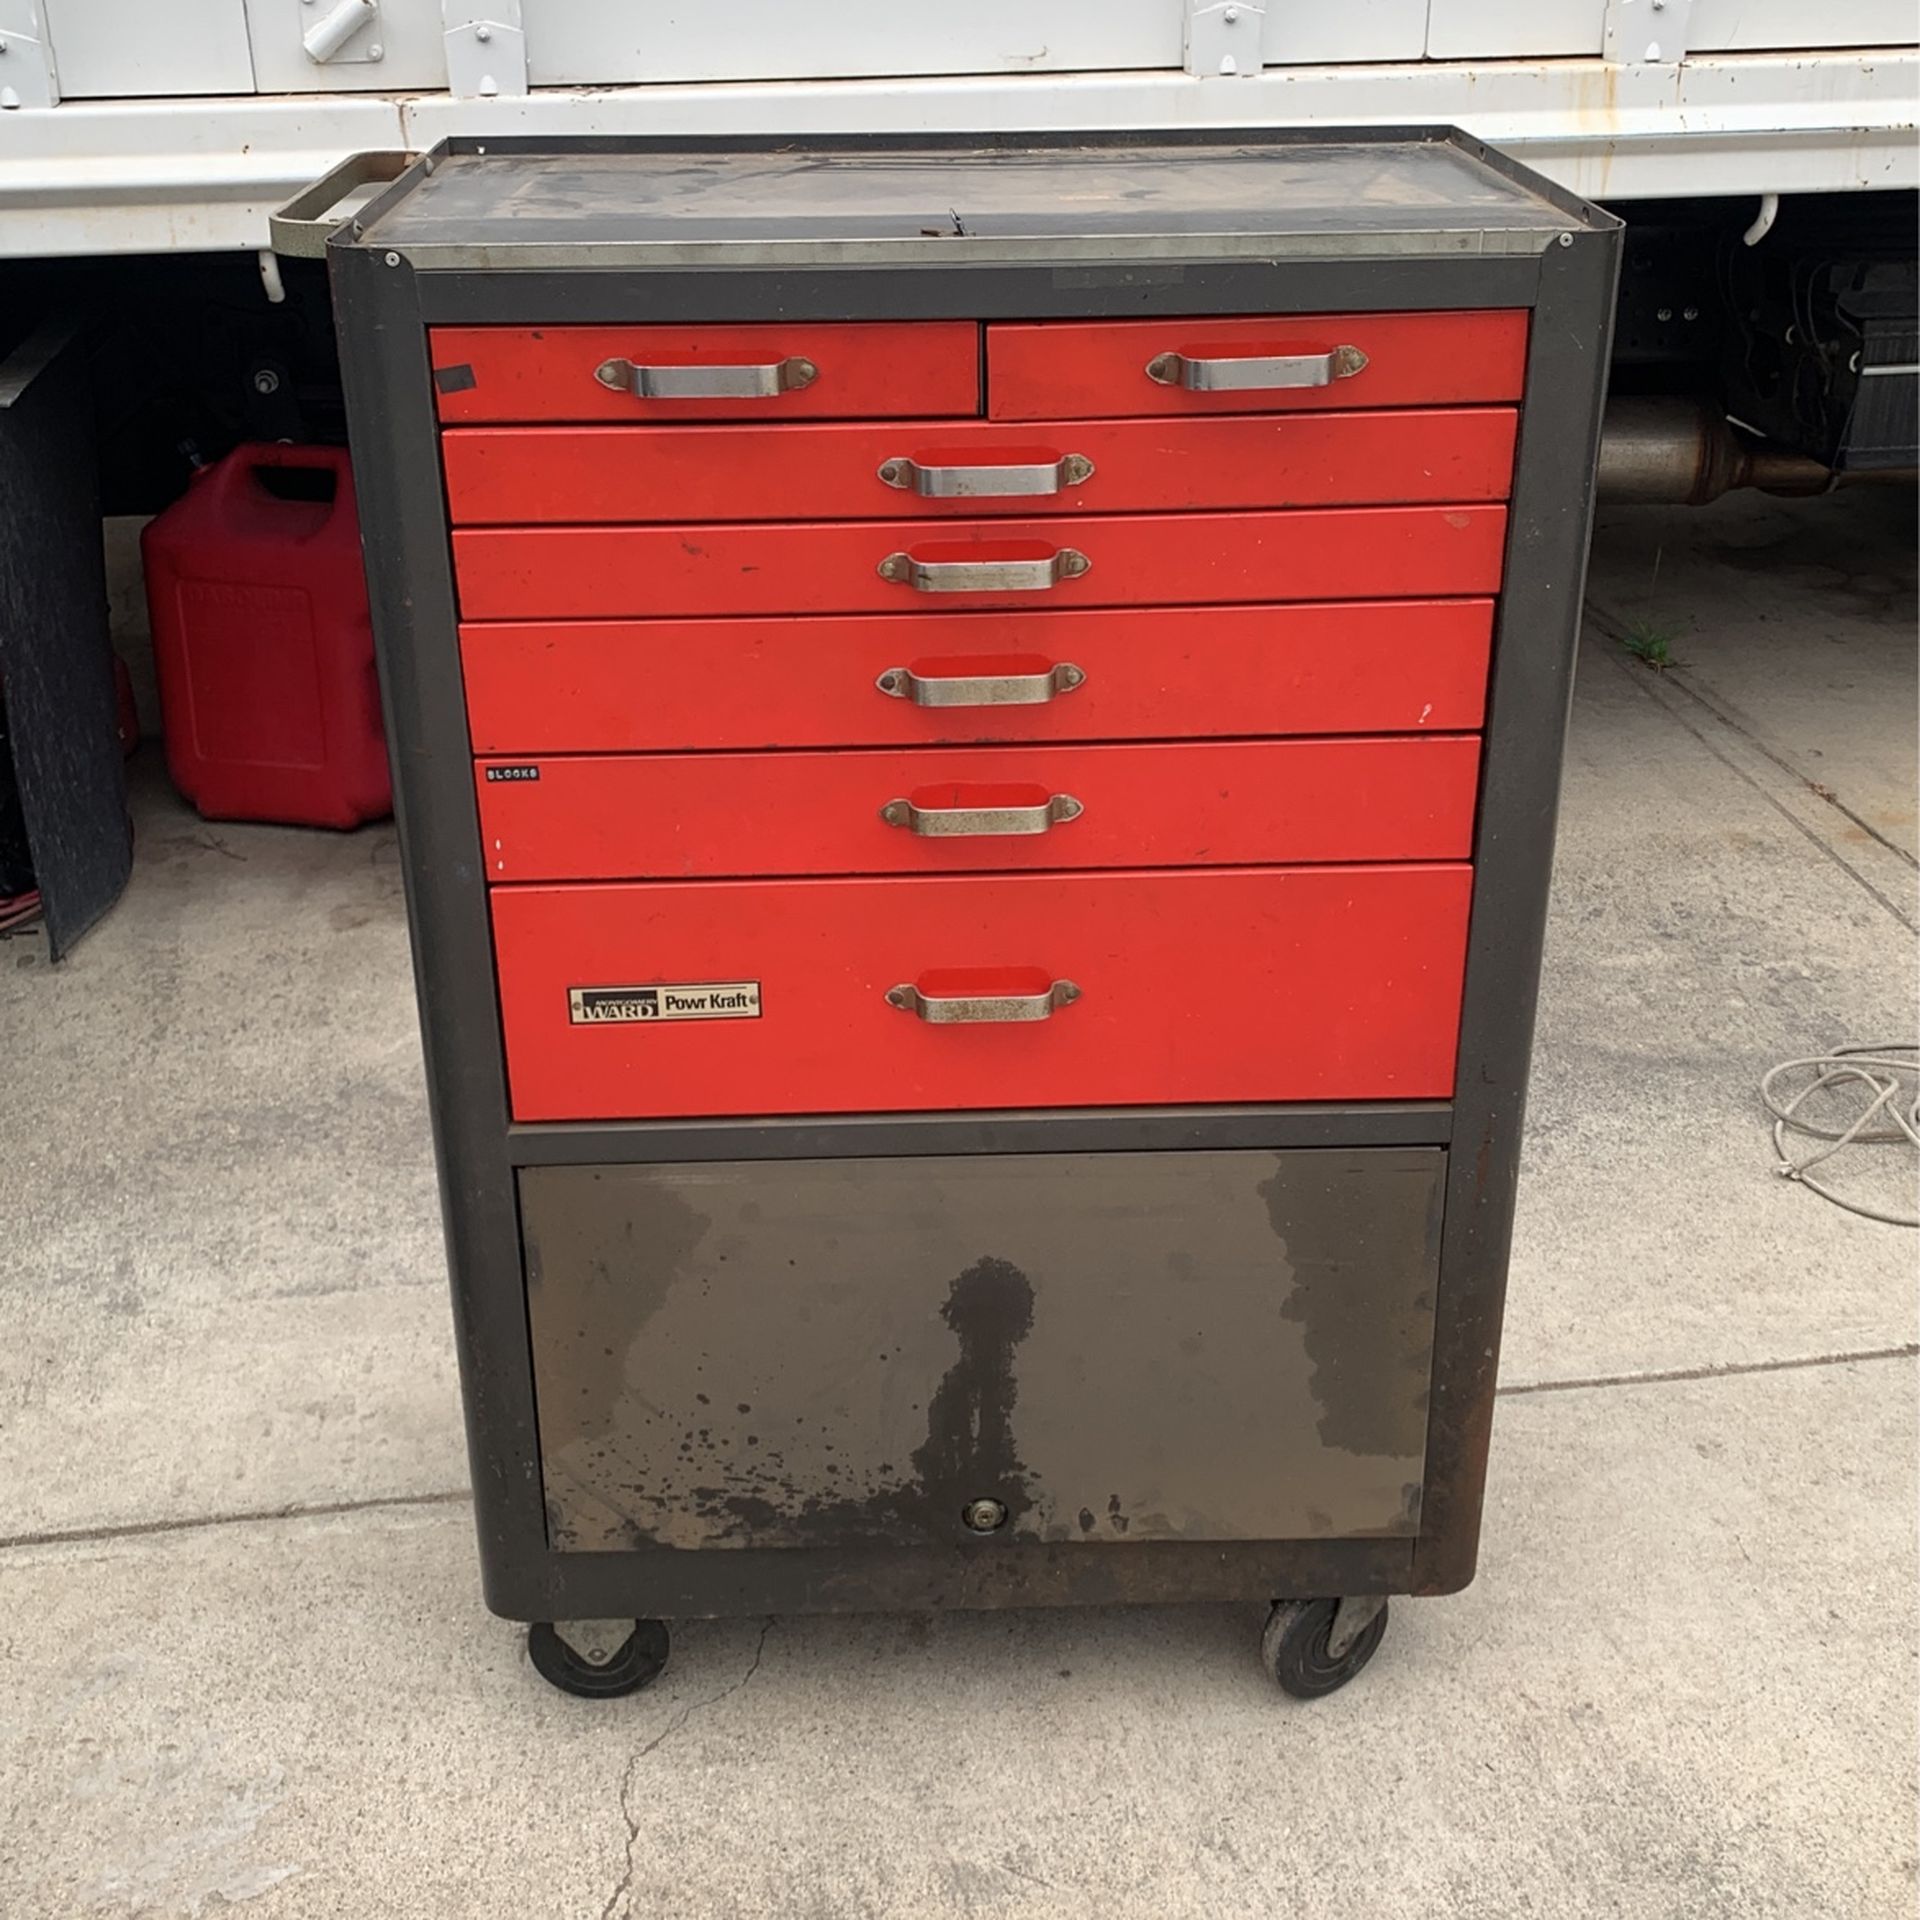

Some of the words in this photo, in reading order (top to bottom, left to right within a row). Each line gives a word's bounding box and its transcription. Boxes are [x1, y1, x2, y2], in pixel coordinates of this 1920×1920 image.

[665, 995, 706, 1010] Powr
[710, 993, 747, 1009] Kraft
[584, 1004, 655, 1019] WARD
